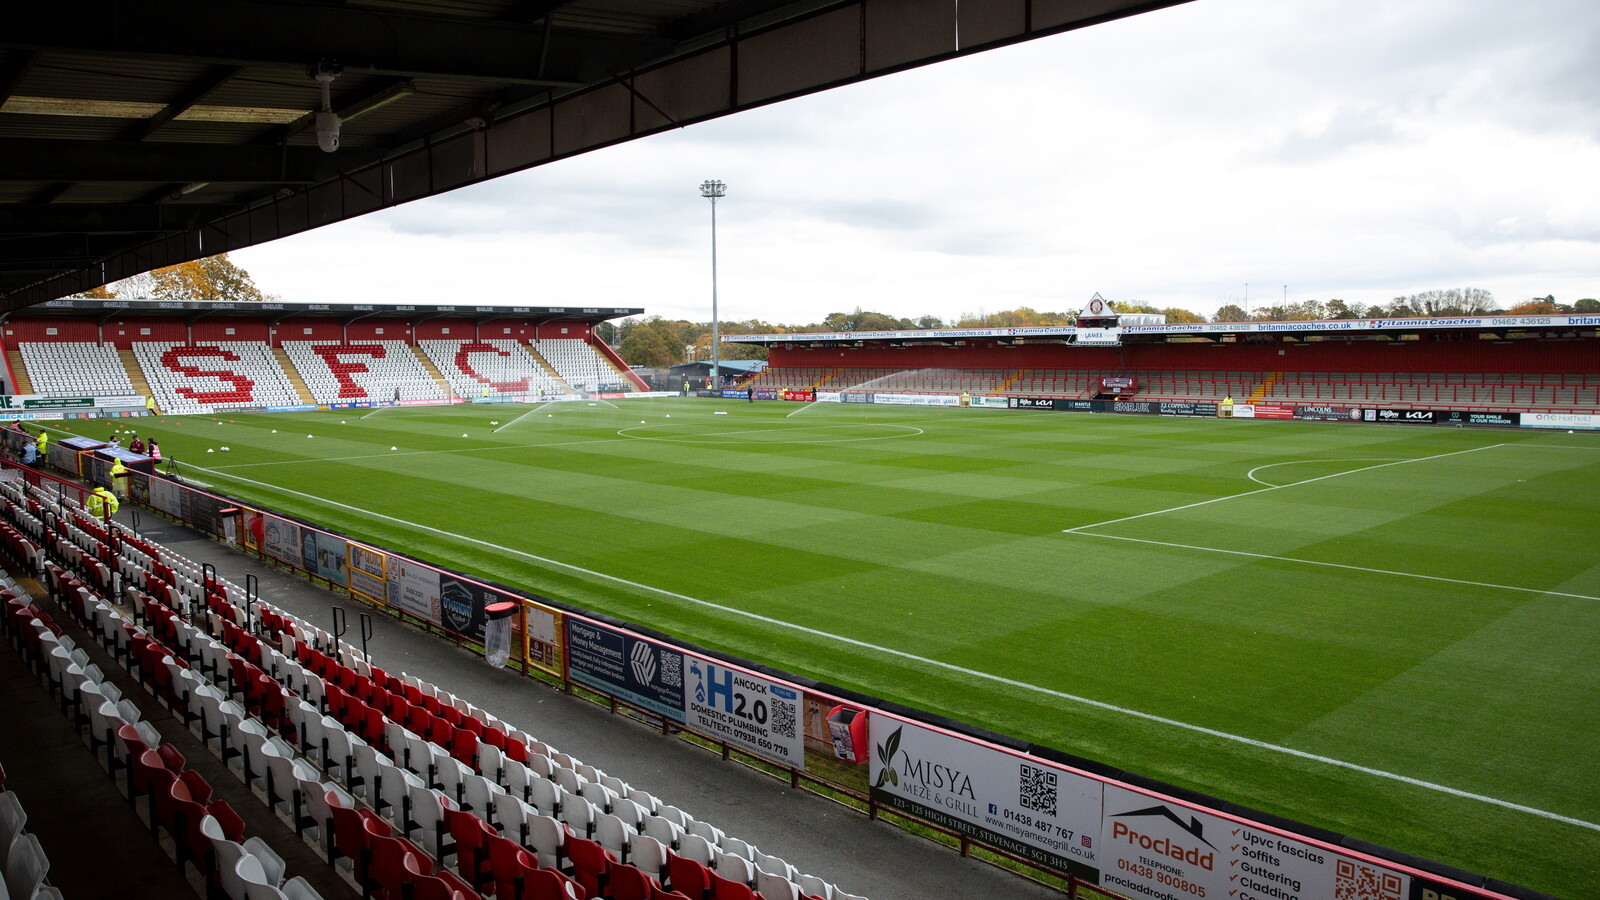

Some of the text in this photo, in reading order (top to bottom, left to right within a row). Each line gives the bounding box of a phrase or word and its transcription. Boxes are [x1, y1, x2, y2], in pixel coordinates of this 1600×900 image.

[1258, 322, 1351, 331] britanniacoaches.co.uk
[1369, 320, 1428, 328] Britannia
[572, 622, 600, 640] Mortgage &
[572, 634, 588, 648] Money
[691, 702, 767, 737] DOMESTIC PLUMBING
[734, 691, 767, 726] 2.0
[698, 715, 788, 756] TEL/TEXT: 07938 650 778
[901, 750, 976, 800] MISYA
[904, 782, 978, 818] MEZE & GRILL
[893, 798, 905, 808] 123
[912, 804, 923, 815] 125
[924, 809, 946, 824] HIGH
[1031, 850, 1047, 862] SG1
[1050, 855, 1068, 869] 3HS
[984, 815, 1096, 861] www.misyamezegrill.co.uk
[1004, 808, 1074, 840] 01438 487 767
[1112, 821, 1213, 871] Procladd
[1242, 846, 1280, 866] Soffits
[1243, 830, 1324, 864] Upvc fascias
[1118, 858, 1206, 898] 01438 900805
[1139, 856, 1184, 877] TELEPHONE:
[1241, 862, 1300, 892] Guttering
